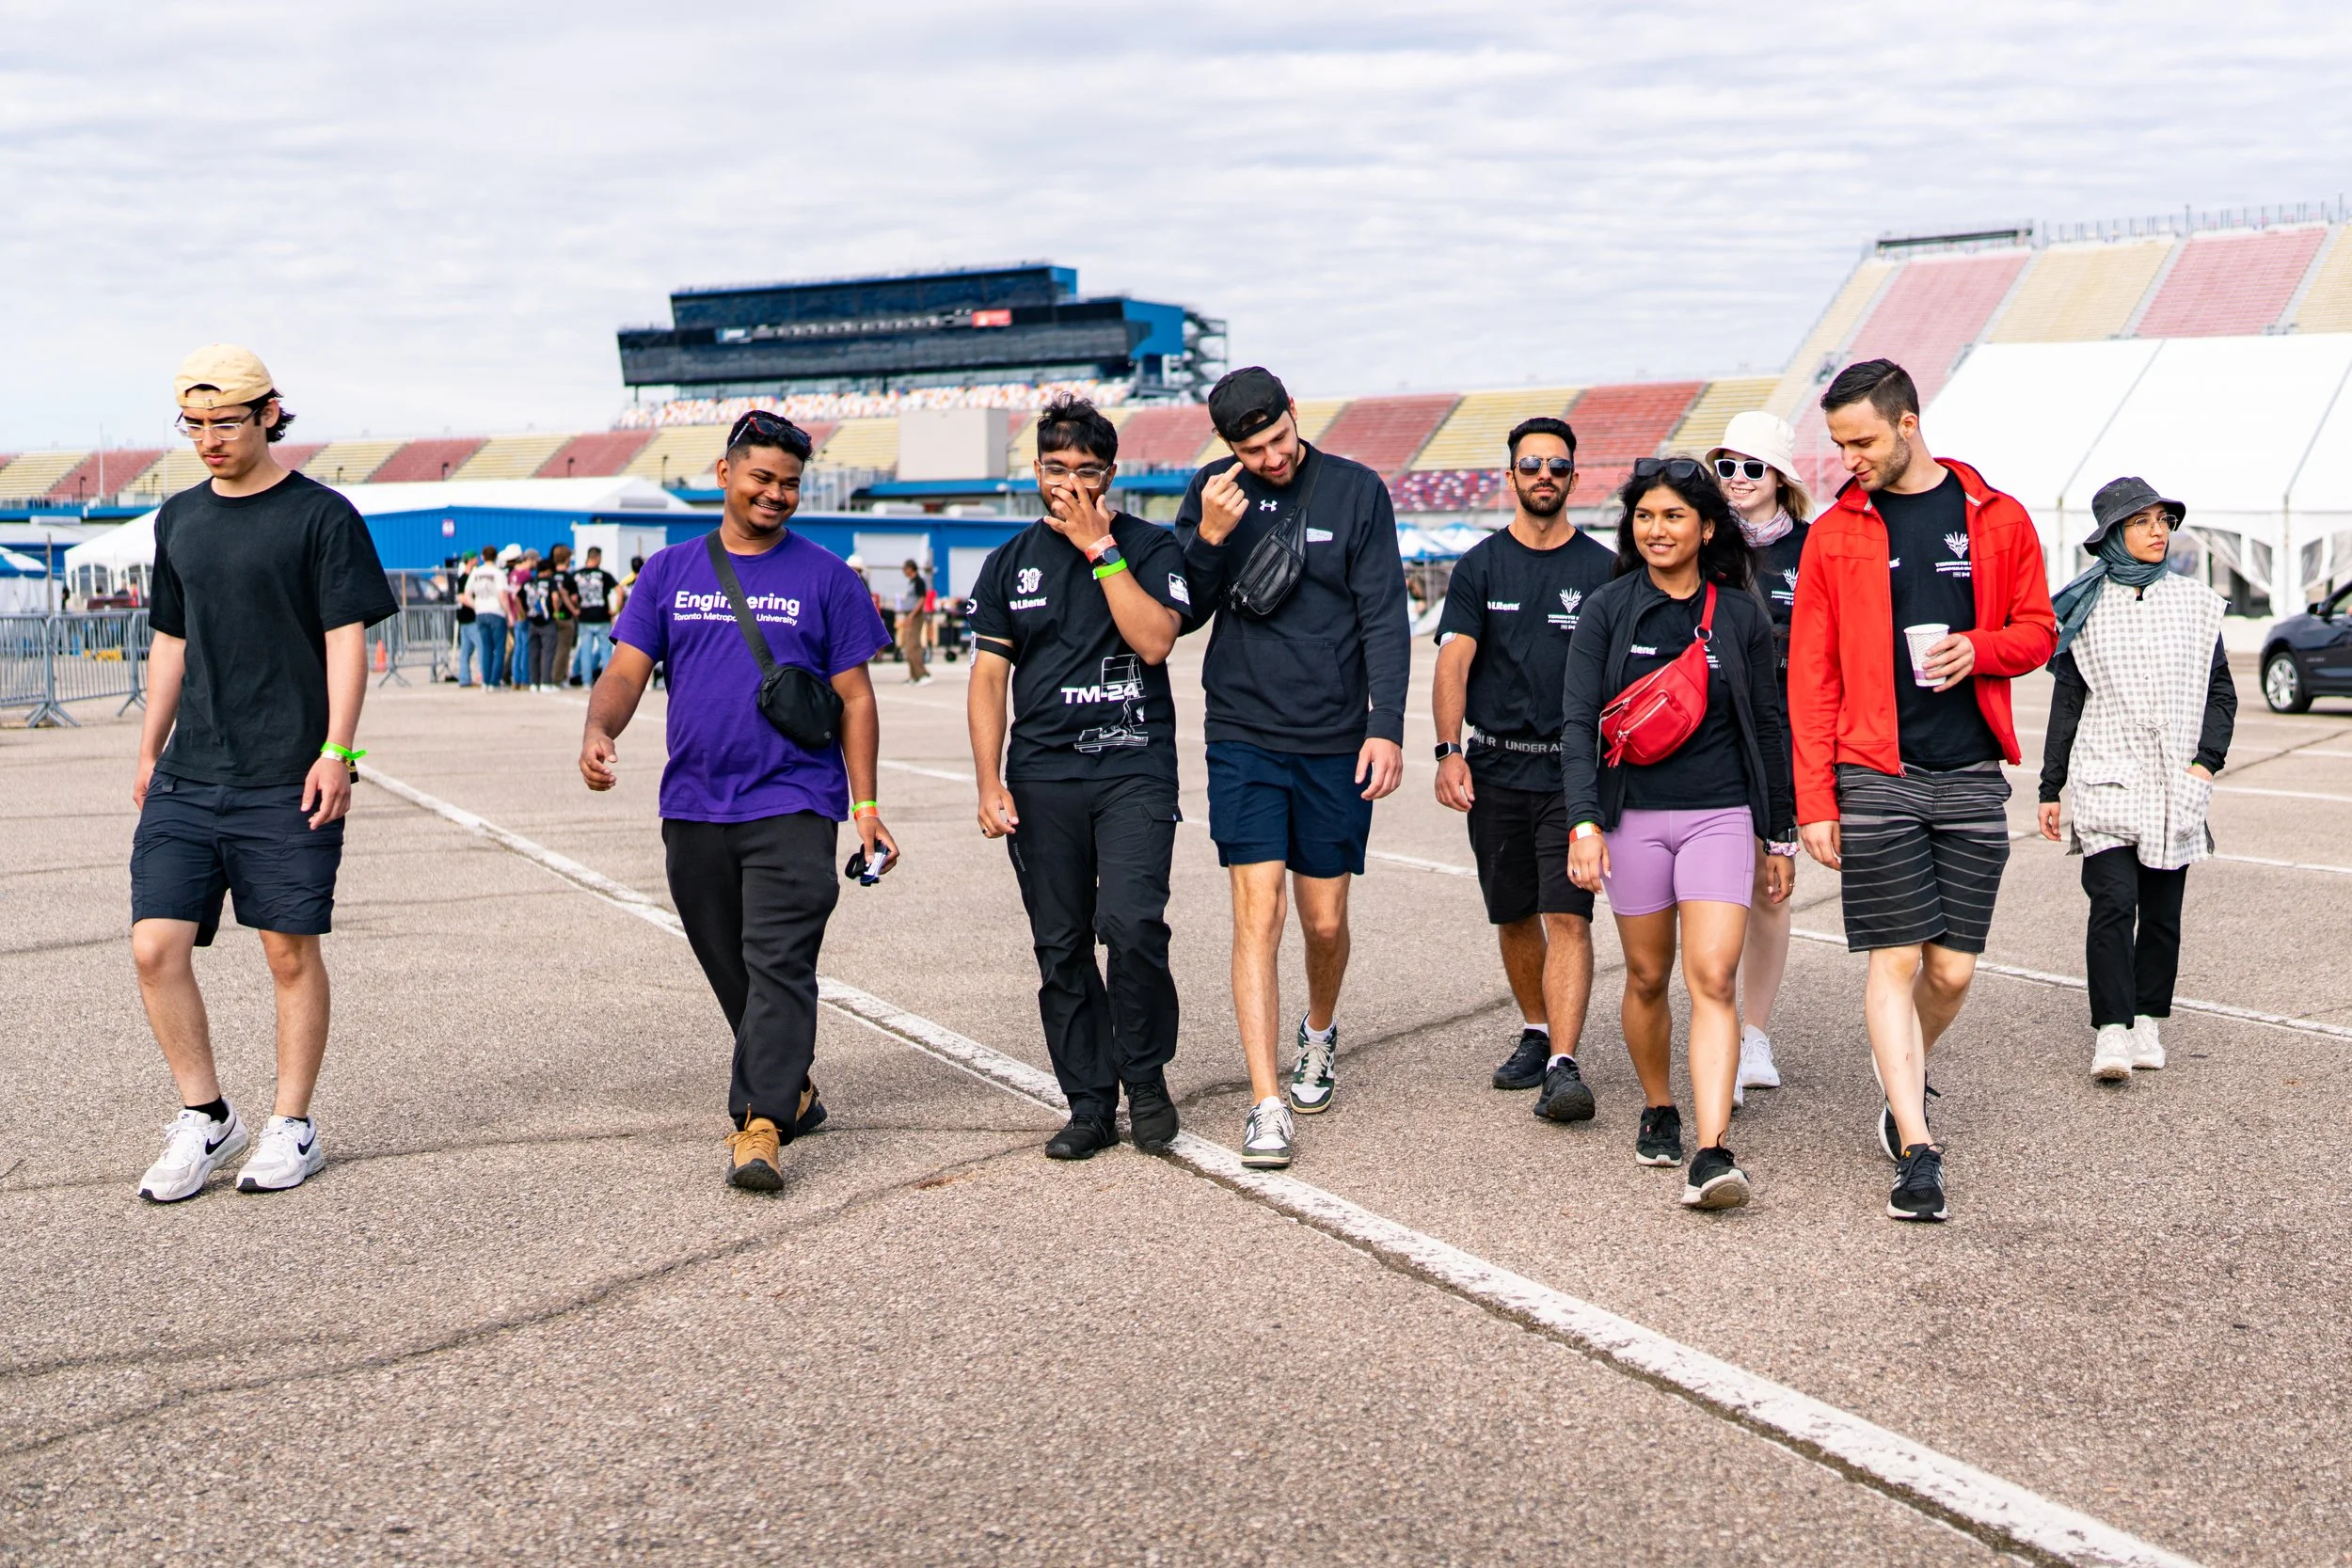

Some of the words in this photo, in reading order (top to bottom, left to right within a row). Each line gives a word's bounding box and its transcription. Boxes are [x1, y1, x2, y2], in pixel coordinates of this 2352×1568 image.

[675, 591, 801, 616] Enginering
[673, 612, 702, 622] Toronto
[755, 613, 798, 626] University
[1060, 682, 1139, 705] TM-24
[1505, 740, 1548, 752] UNDER
